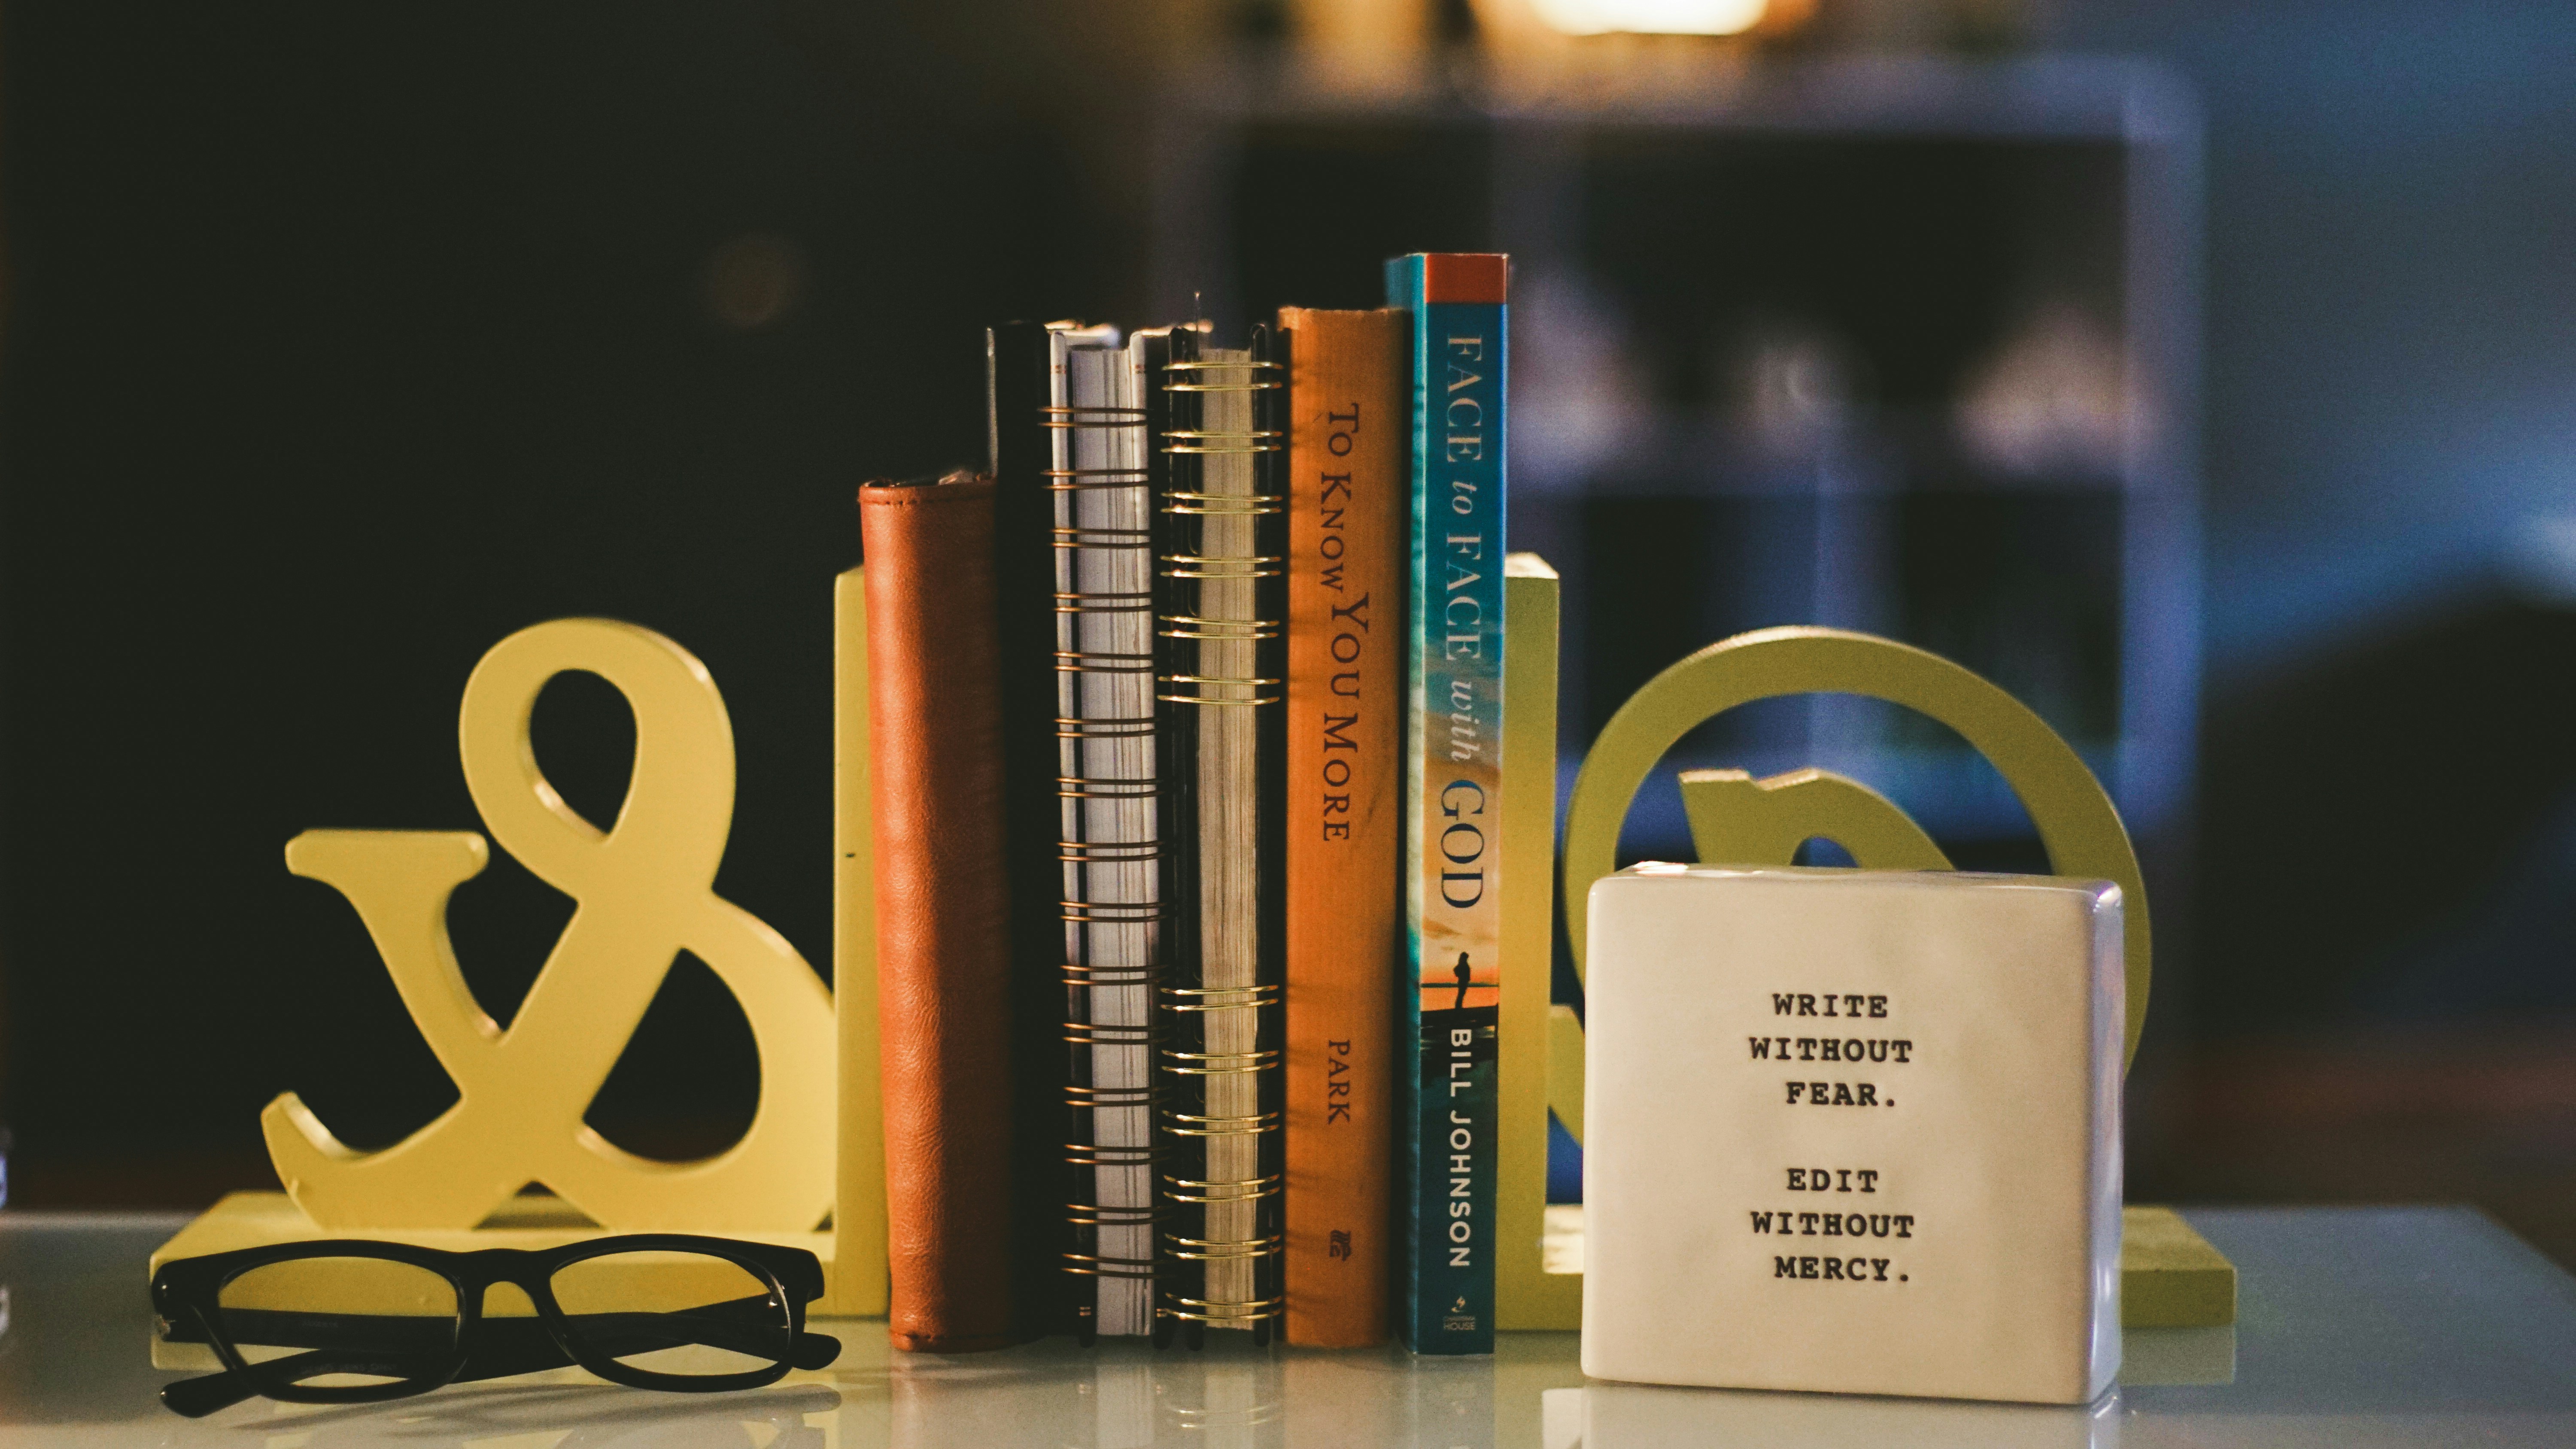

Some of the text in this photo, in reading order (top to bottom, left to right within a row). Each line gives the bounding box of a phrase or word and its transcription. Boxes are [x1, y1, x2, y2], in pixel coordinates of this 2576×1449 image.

[1440, 333, 1484, 909] FACE to FACE with GOD
[1772, 993, 1889, 1018] WRITE
[1748, 1037, 1913, 1063] WITHOUT
[1328, 1039, 1350, 1125] PARK
[1786, 1082, 1895, 1106] FEAR.
[1449, 1029, 1472, 1267] BILL JOHNSON
[1786, 1168, 1878, 1193] EDIT
[1750, 1211, 1914, 1238] WITHOUT
[1774, 1256, 1909, 1282] MERCY.
